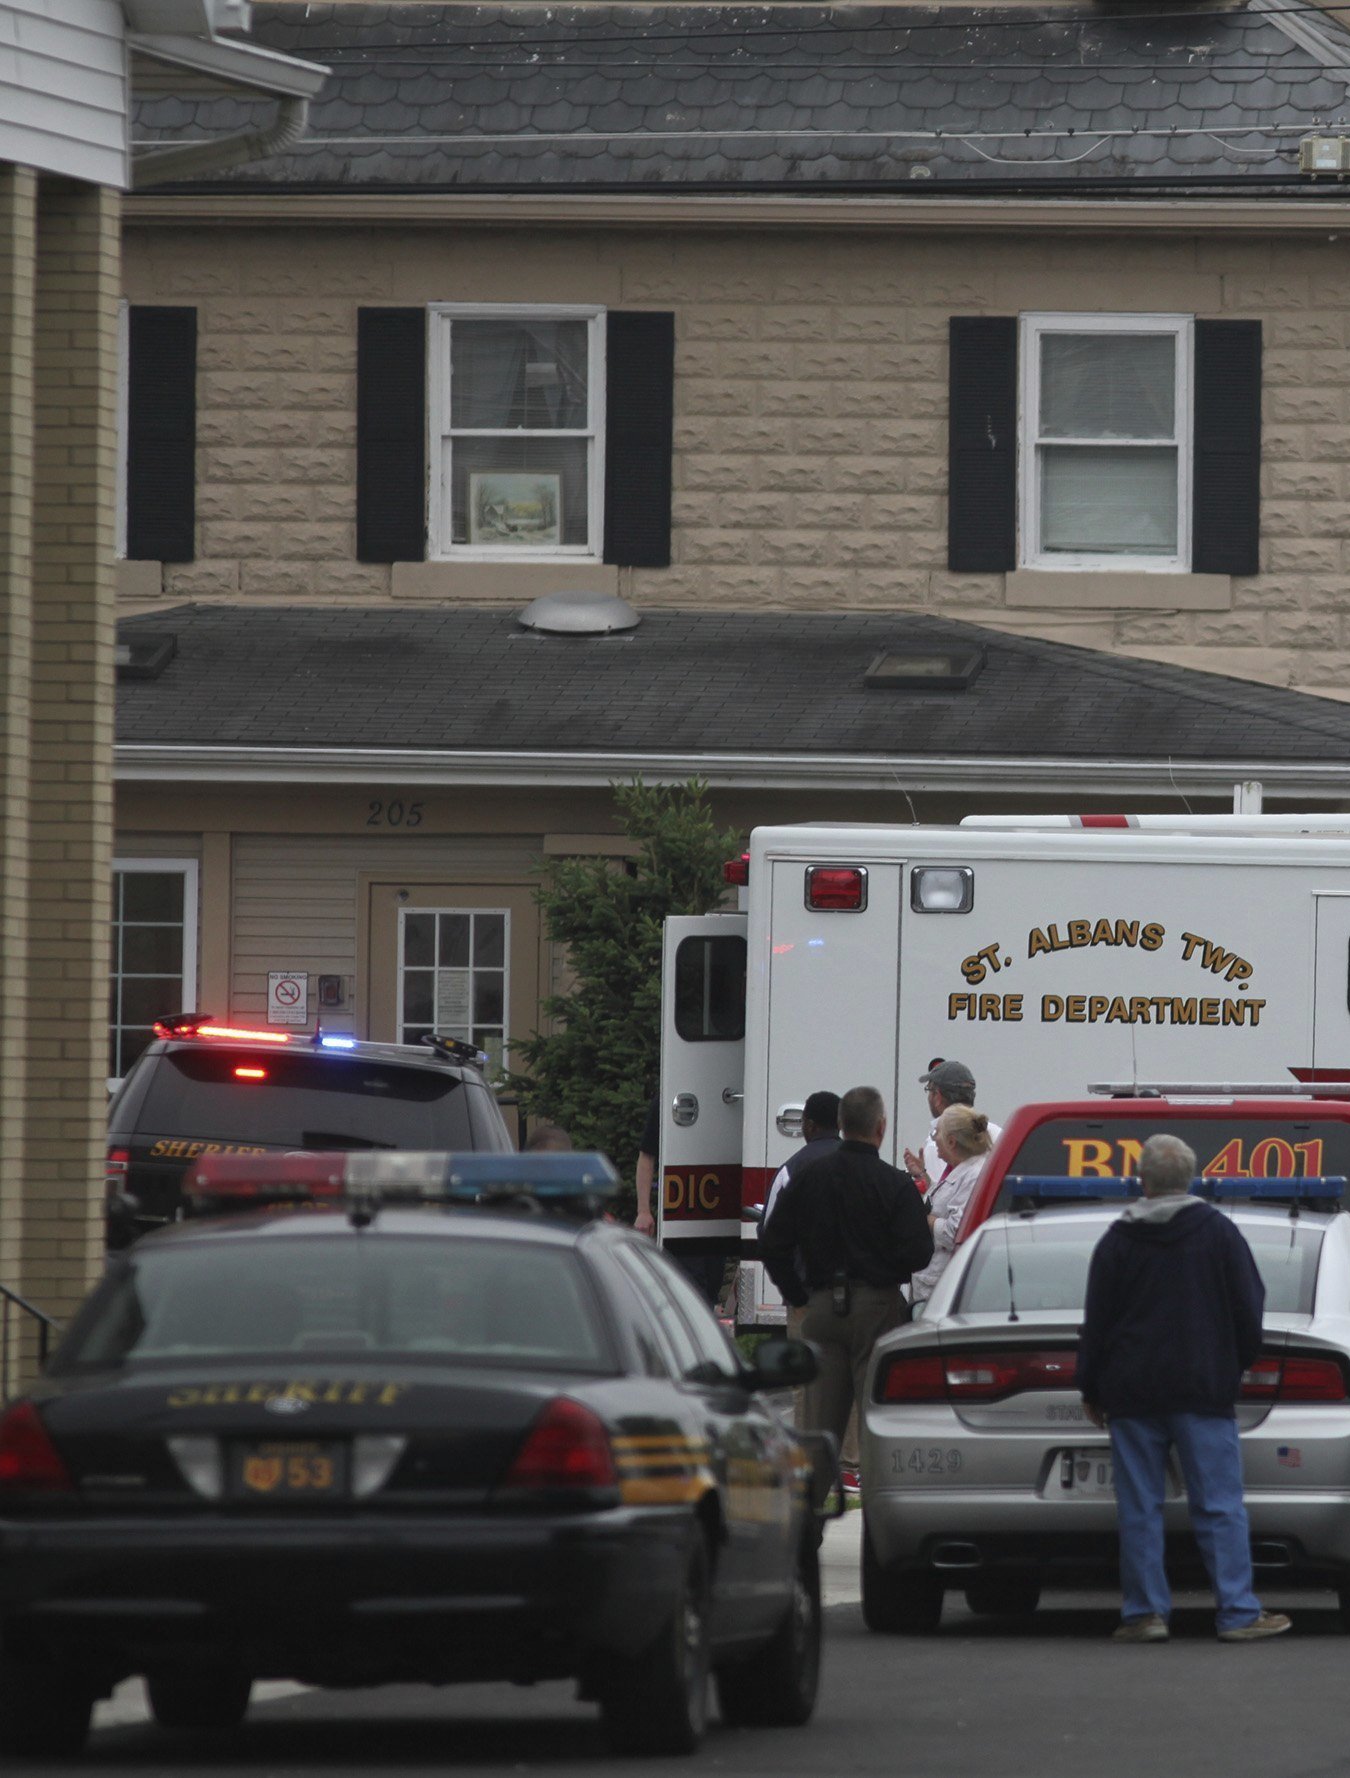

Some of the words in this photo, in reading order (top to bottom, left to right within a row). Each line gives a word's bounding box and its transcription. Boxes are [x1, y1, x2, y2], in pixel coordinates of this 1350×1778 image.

[367, 801, 425, 827] 205
[961, 942, 1013, 985] ST.
[1028, 918, 1166, 958] ALBANS
[1181, 932, 1254, 991] TWP.
[948, 993, 1024, 1022] FIRE
[1041, 995, 1267, 1026] DEPARTMENT
[1201, 1137, 1323, 1178] 401
[664, 1172, 721, 1213] DIC
[287, 1456, 334, 1489] 53
[891, 1449, 963, 1474] 1429
